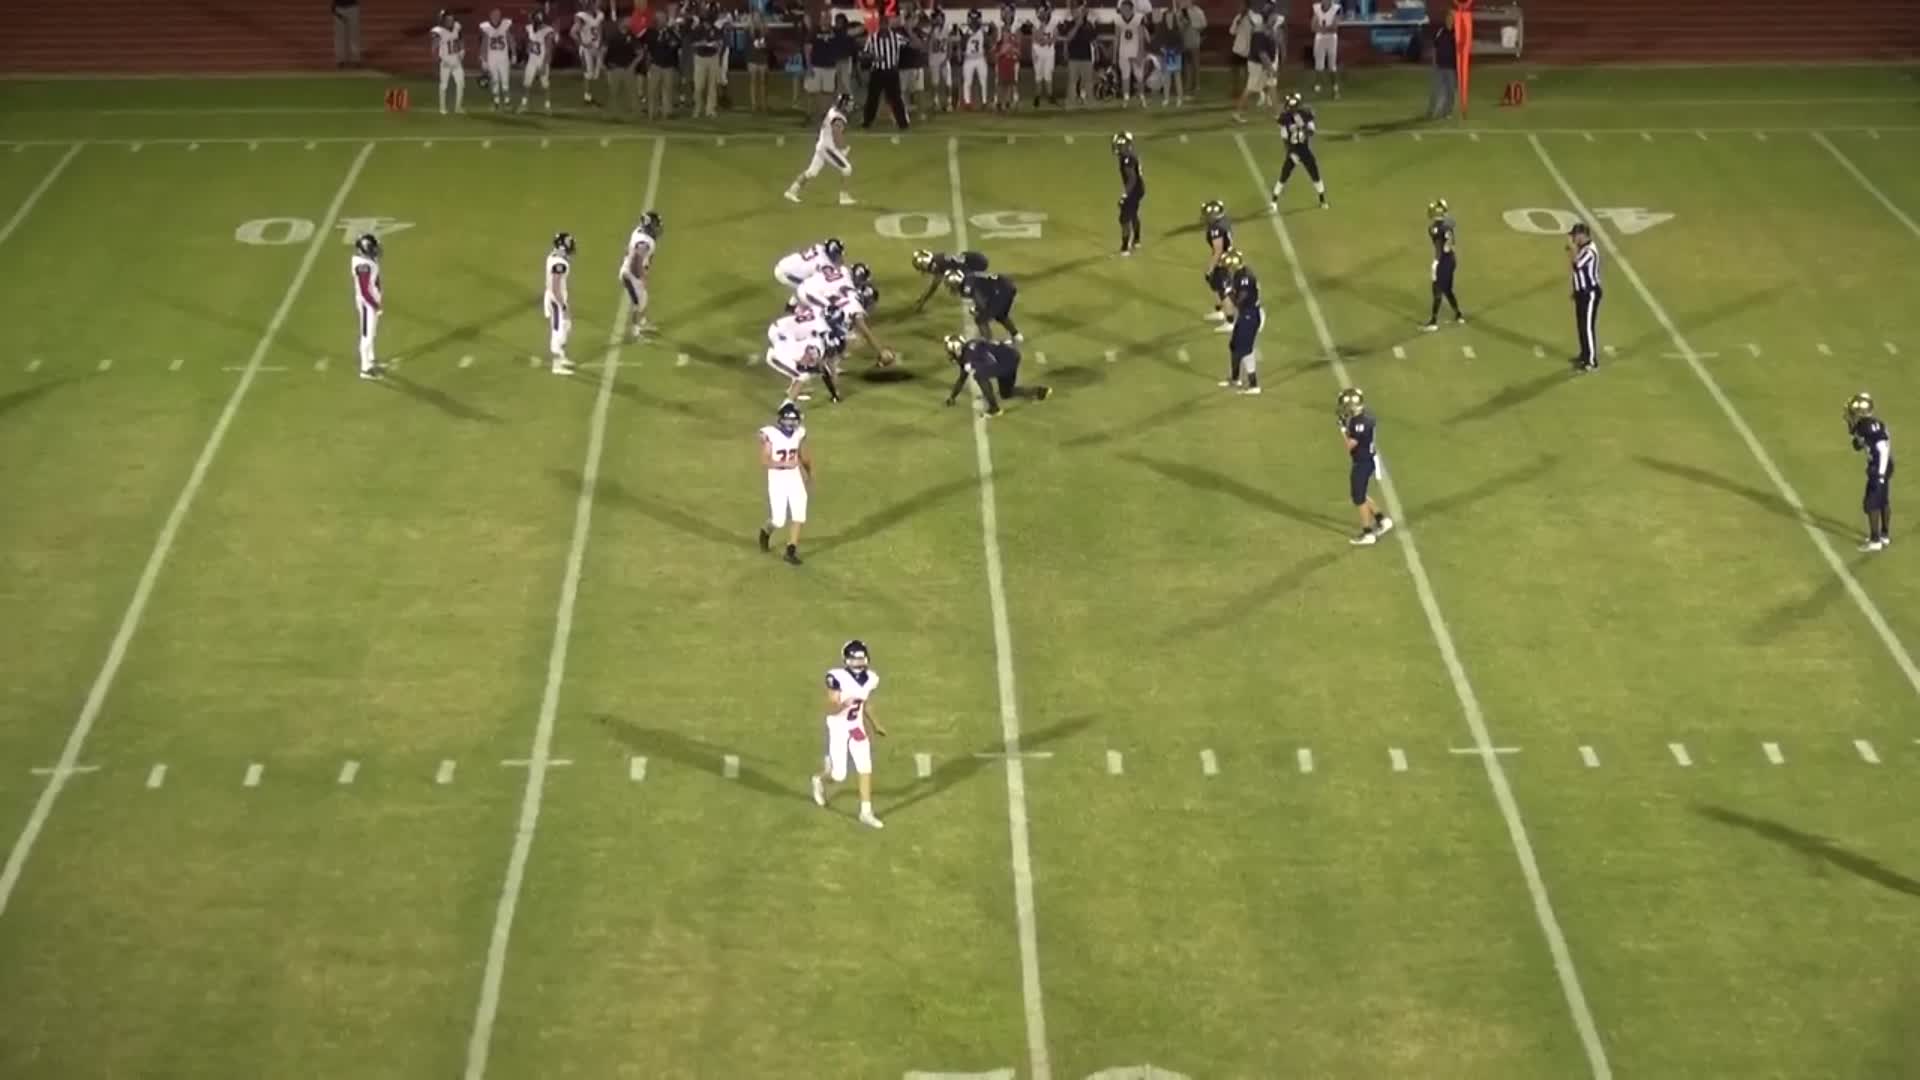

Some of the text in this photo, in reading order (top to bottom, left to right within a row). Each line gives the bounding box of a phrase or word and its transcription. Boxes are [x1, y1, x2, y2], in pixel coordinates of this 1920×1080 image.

[384, 87, 409, 112] 40
[1499, 80, 1526, 109] 40
[234, 217, 417, 245] 40
[874, 210, 1048, 239] 50
[1502, 207, 1676, 235] 40
[847, 699, 864, 721] 2
